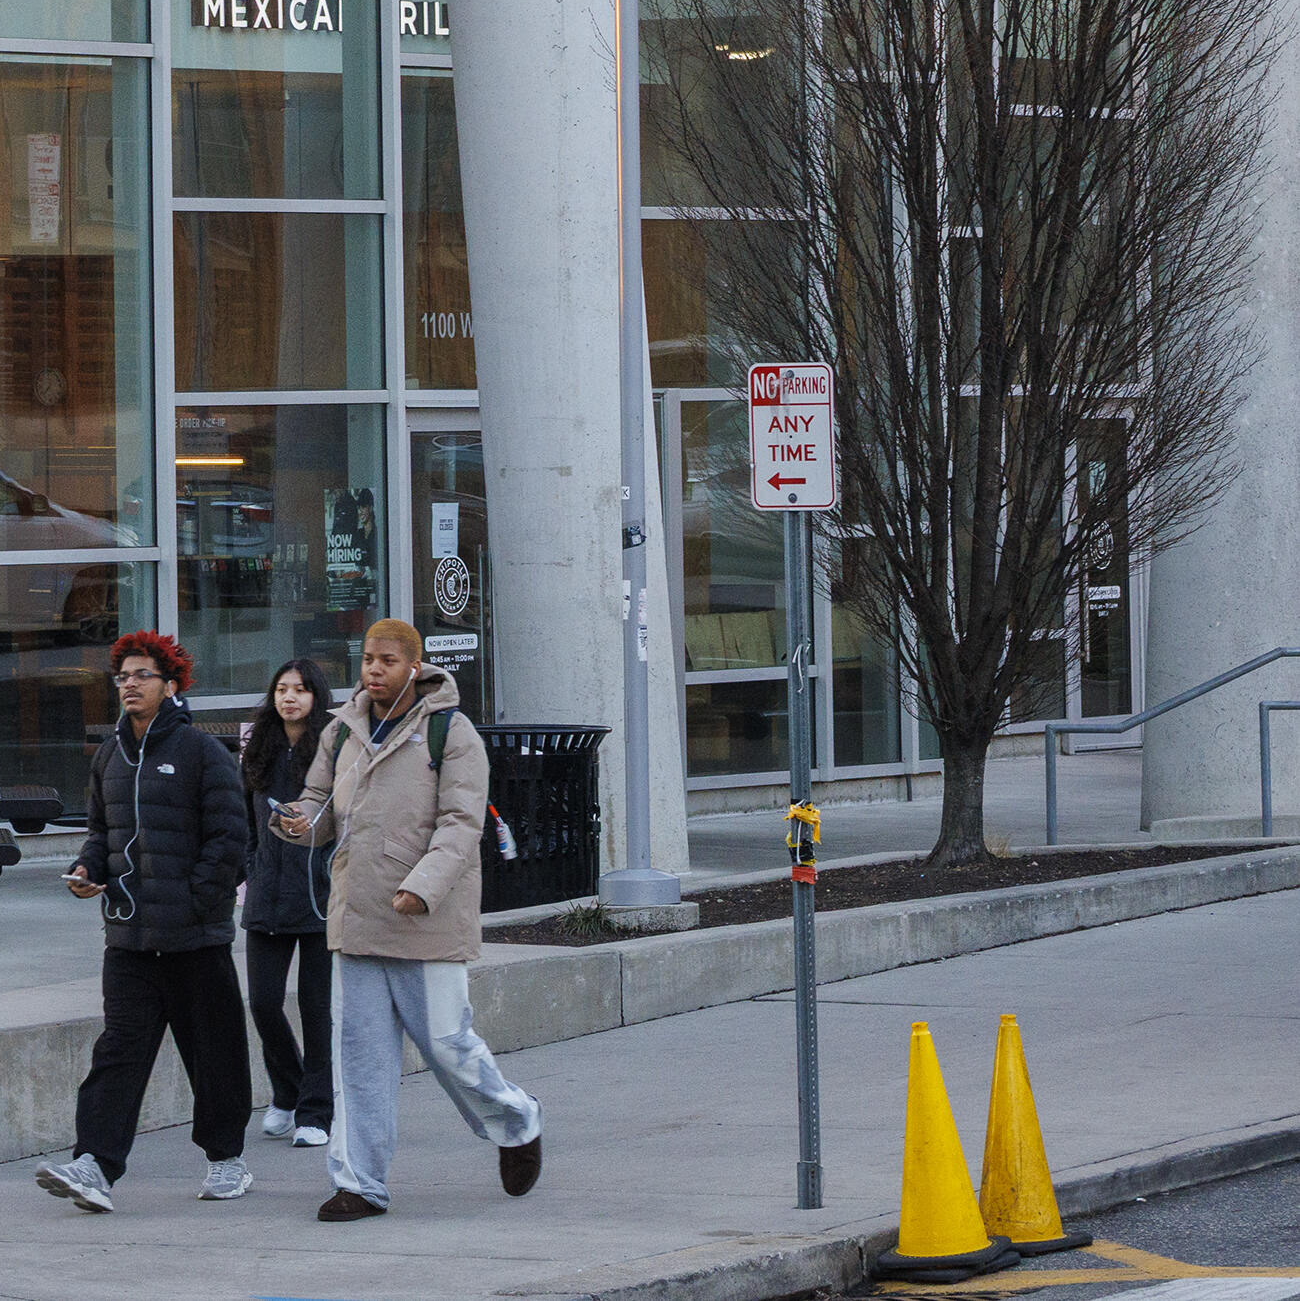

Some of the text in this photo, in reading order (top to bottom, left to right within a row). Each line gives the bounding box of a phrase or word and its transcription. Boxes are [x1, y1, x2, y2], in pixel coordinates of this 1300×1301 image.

[400, 1, 450, 36] RIL
[421, 312, 455, 338] 1100
[753, 373, 826, 399] NO PARKING
[768, 415, 814, 433] ANY
[768, 444, 816, 461] TIME
[326, 534, 352, 547] NOW
[327, 549, 361, 562] HIRING
[437, 556, 467, 581] CHIPOTLE
[428, 637, 475, 647] NOW OPEN LATER
